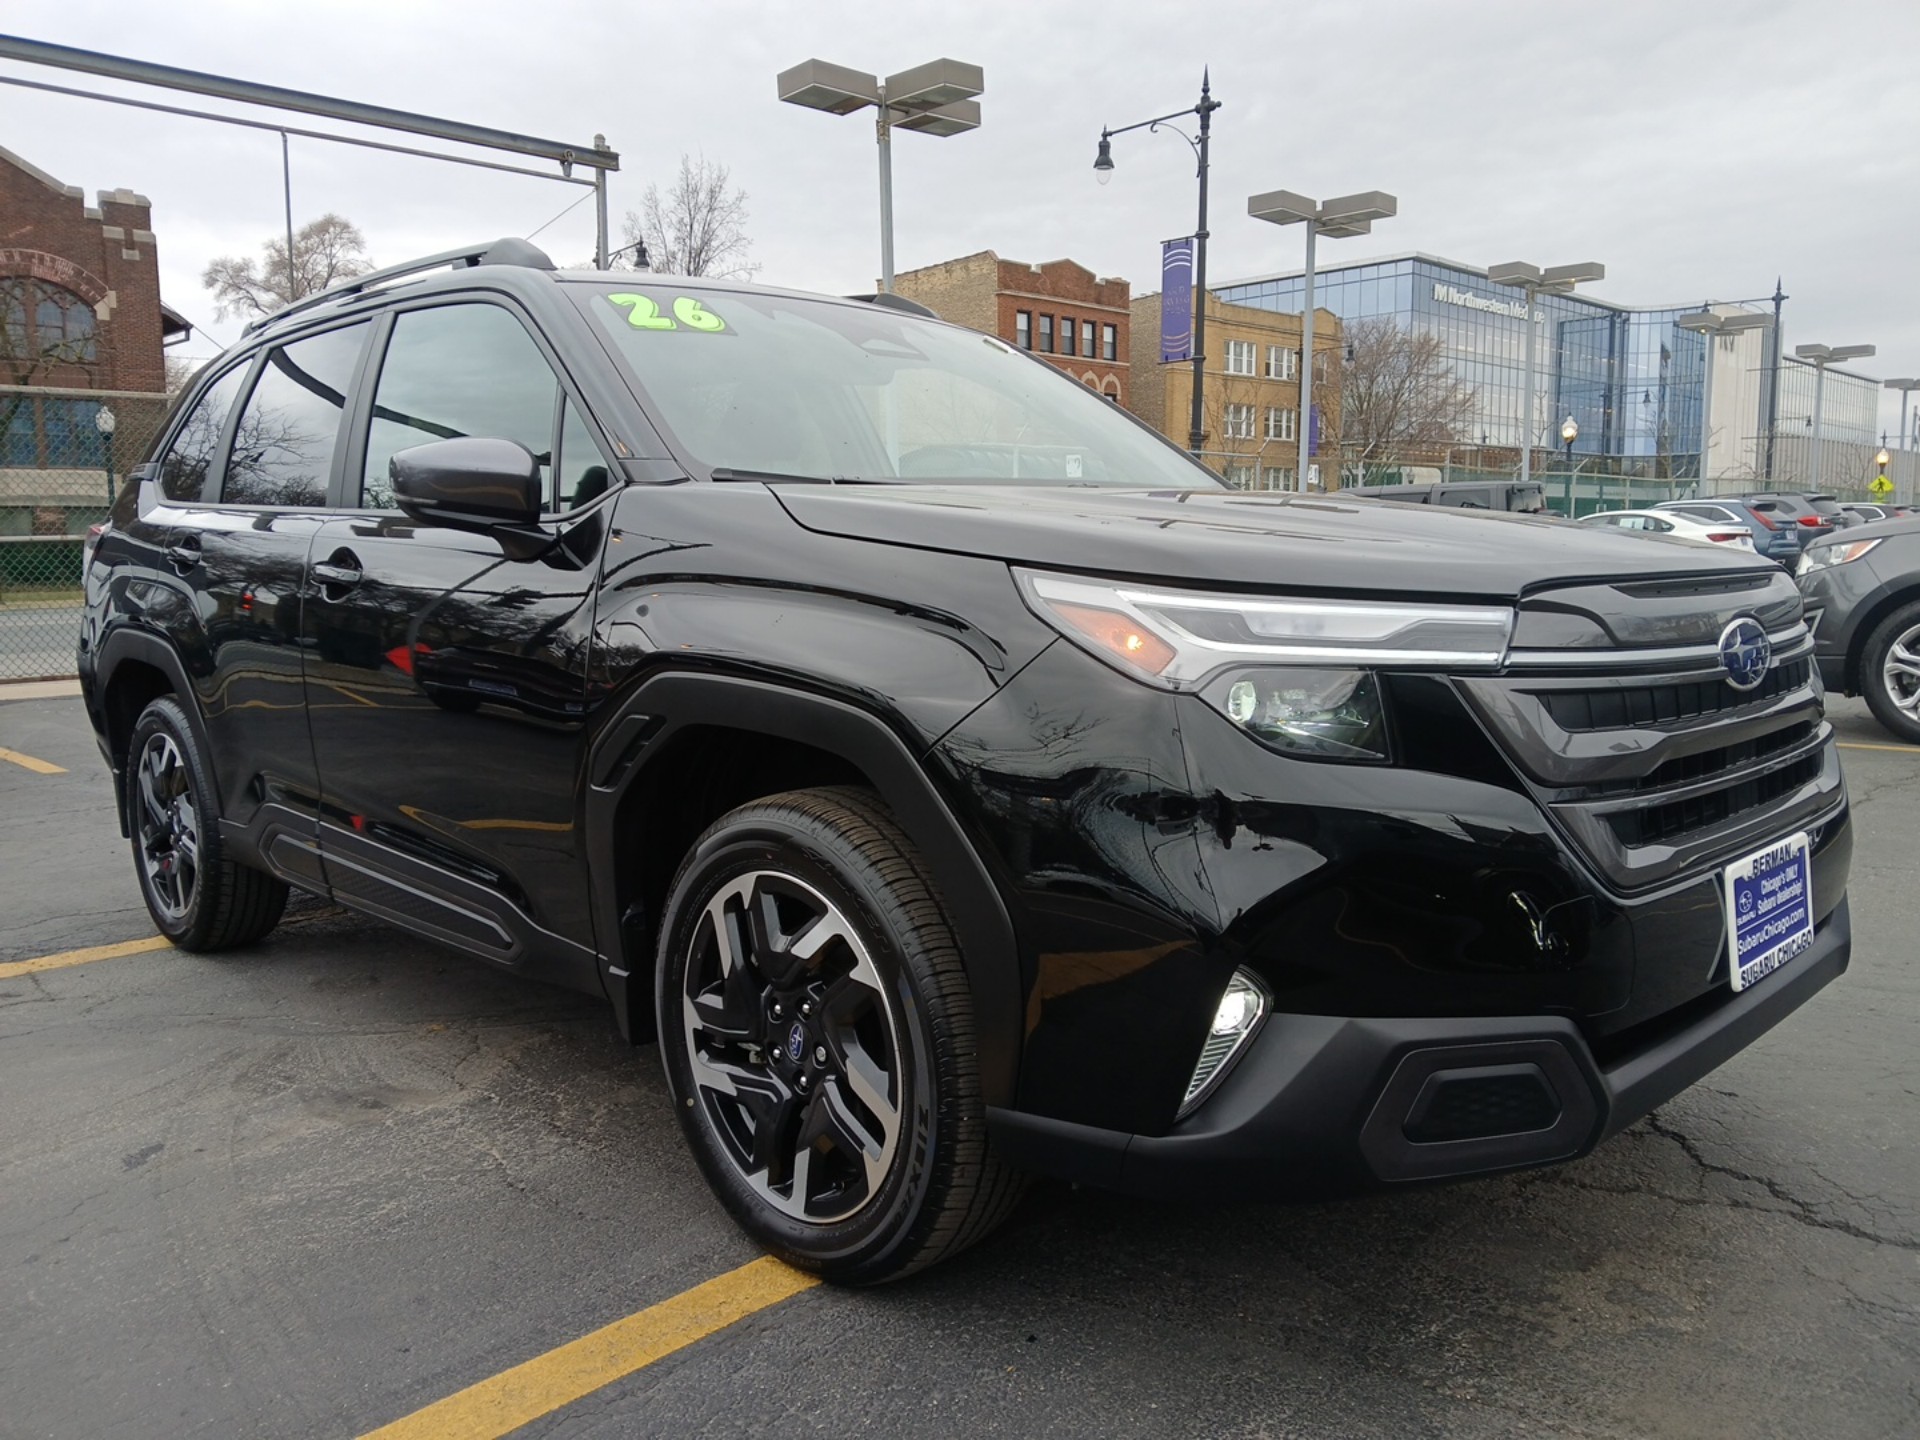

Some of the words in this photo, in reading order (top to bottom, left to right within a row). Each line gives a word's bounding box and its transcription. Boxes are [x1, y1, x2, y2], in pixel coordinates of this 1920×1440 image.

[608, 292, 726, 332] 26
[1449, 287, 1509, 315] Northwestern
[1510, 301, 1545, 323] Medne
[1752, 842, 1793, 877] BERMAN
[1761, 871, 1785, 895] Chicago's
[1785, 864, 1798, 881] ONLY
[1736, 910, 1757, 927] SUBARU
[1757, 897, 1777, 915] Subaru
[1738, 907, 1805, 955] SubaruChicago.com
[1740, 953, 1776, 989] SUBARU
[1776, 929, 1814, 965] CHICAGO
